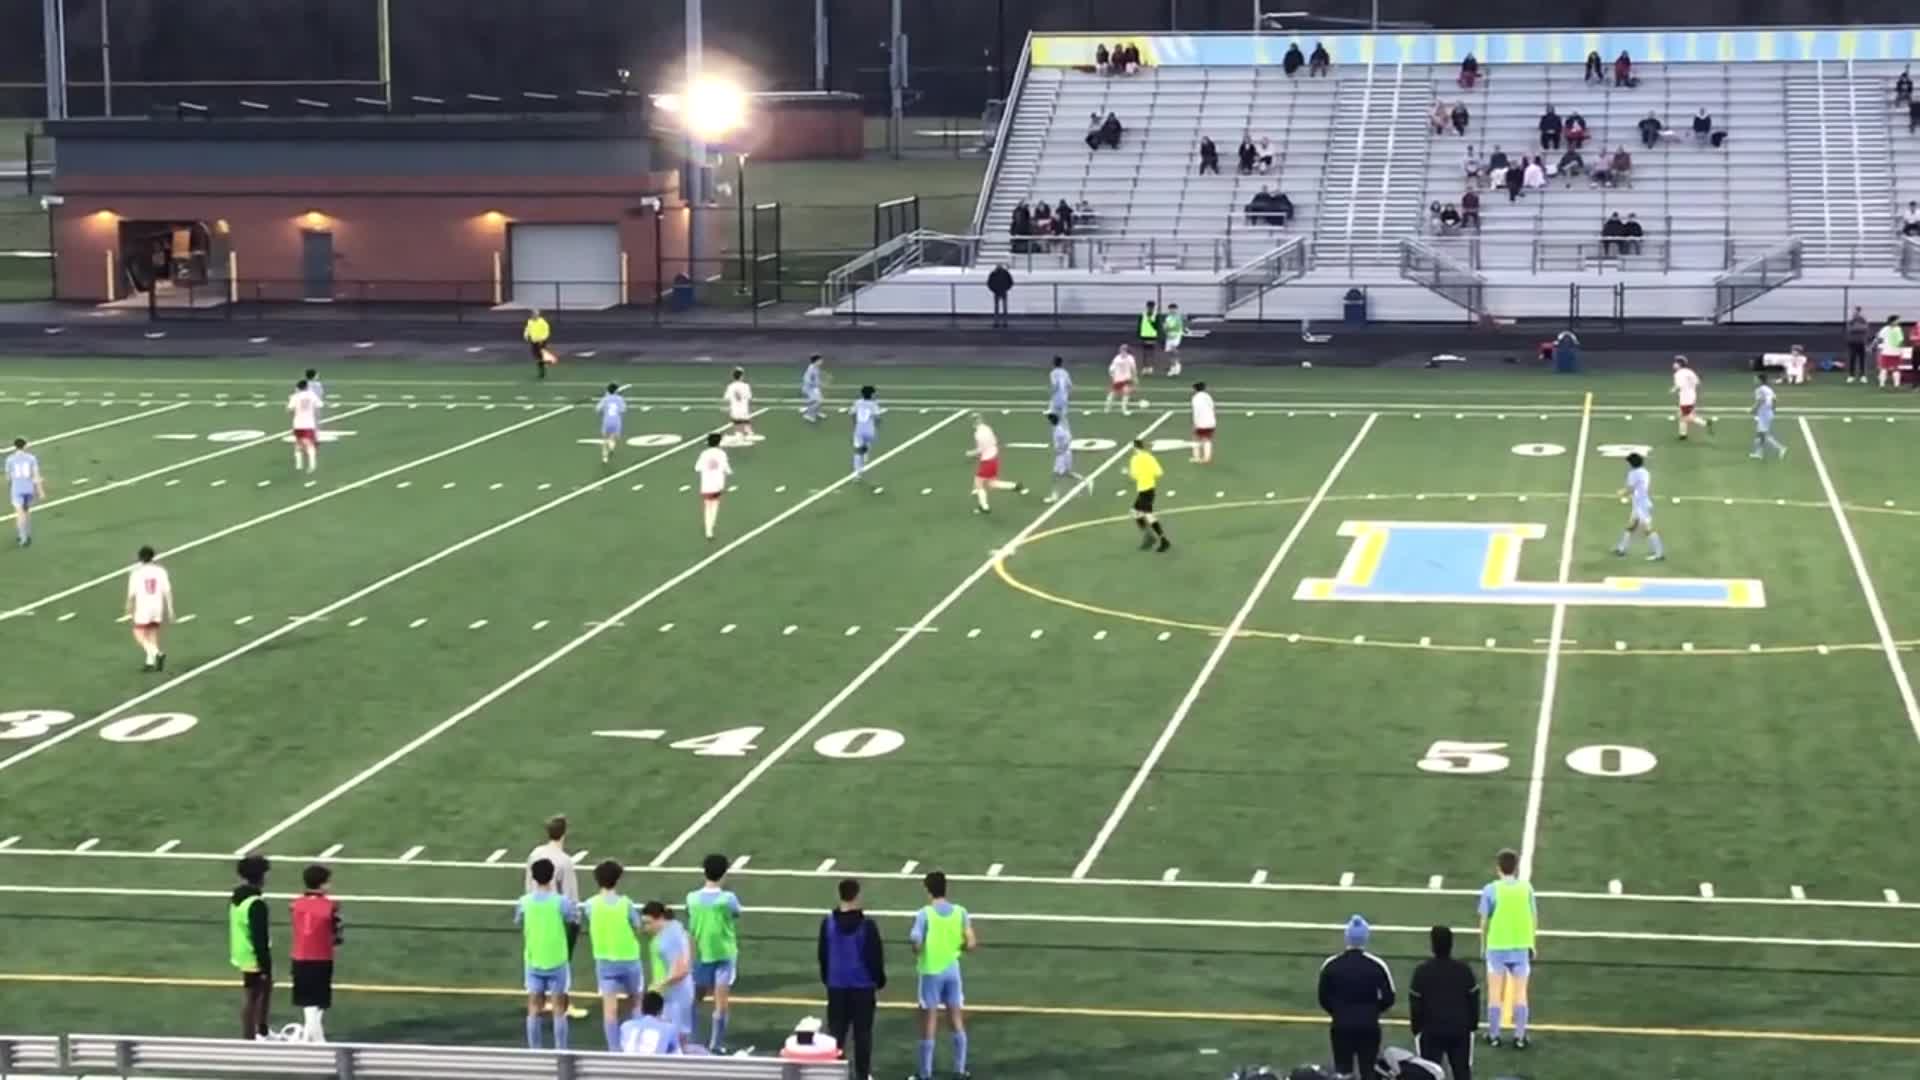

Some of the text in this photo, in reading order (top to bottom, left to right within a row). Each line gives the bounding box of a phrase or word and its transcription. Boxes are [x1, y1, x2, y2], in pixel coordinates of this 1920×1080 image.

[1292, 519, 1767, 608] L
[670, 725, 906, 759] 40
[1416, 740, 1658, 777] 50
